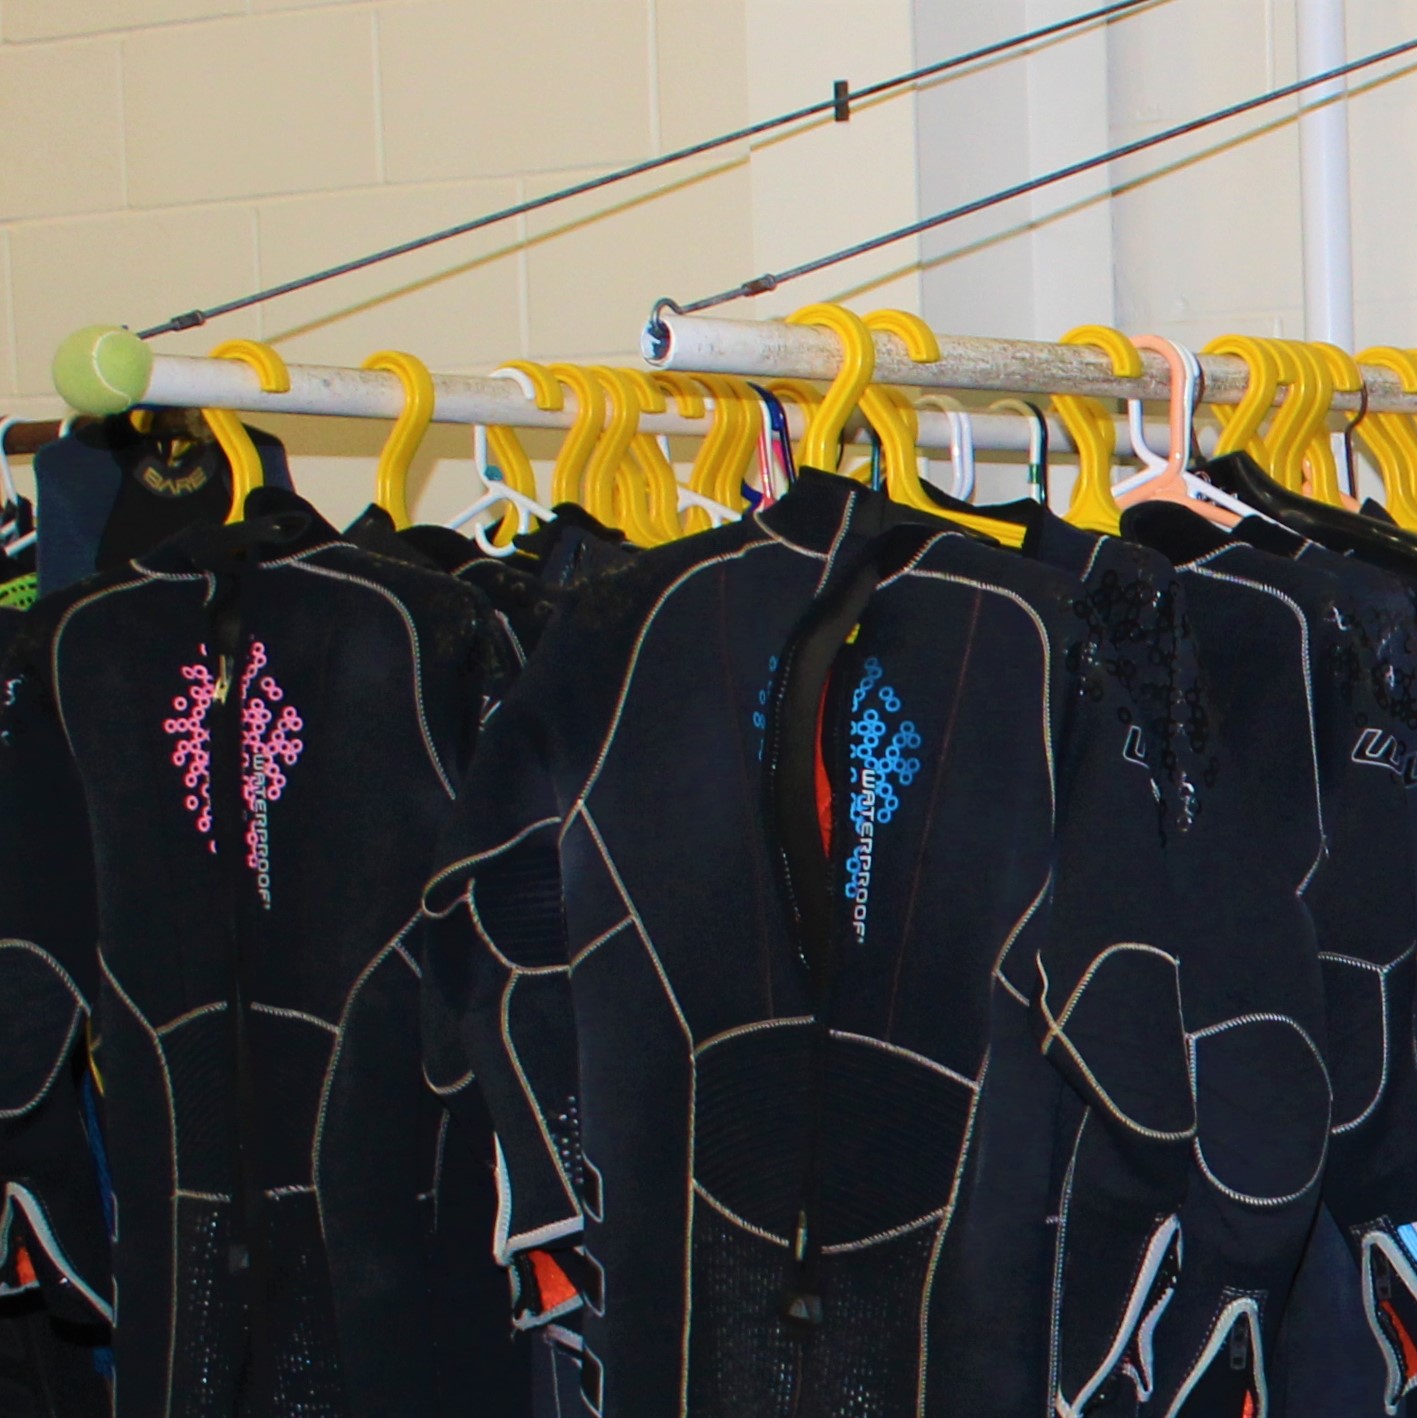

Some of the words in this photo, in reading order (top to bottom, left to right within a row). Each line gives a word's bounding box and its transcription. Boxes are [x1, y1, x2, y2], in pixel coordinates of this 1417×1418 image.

[143, 465, 208, 495] BARE
[251, 753, 271, 904] WATERPROOF
[852, 769, 877, 938] WATERPROOF
